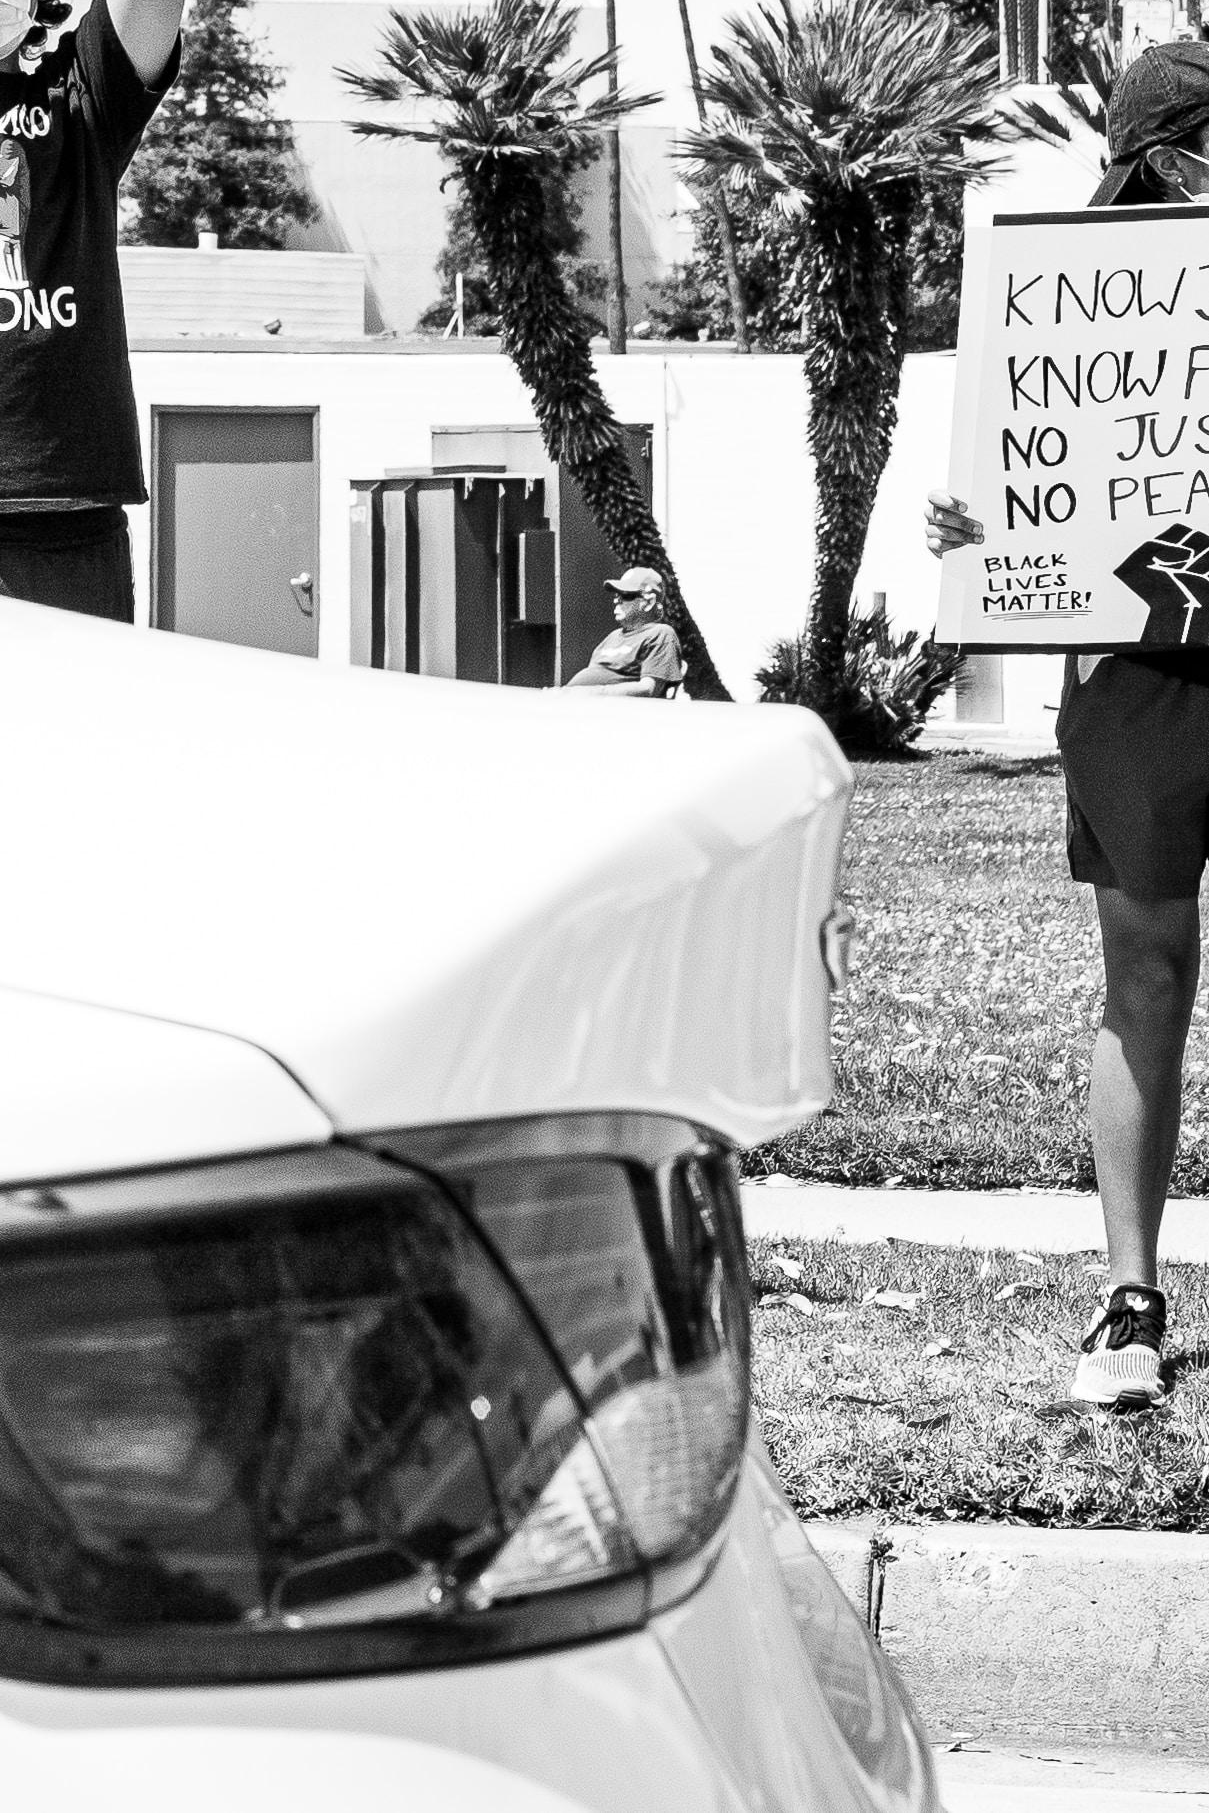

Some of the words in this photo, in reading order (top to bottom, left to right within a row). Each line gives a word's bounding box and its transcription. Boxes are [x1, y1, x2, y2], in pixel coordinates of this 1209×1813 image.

[1005, 267, 1187, 327] KNOW
[1007, 348, 1168, 411] KNOW
[1002, 425, 1068, 471] NO
[1005, 482, 1077, 530] NO
[1108, 469, 1209, 522] PEA
[984, 553, 1068, 574] BLACK
[988, 573, 1068, 592] LIVES
[982, 590, 1092, 613] MATTER!
